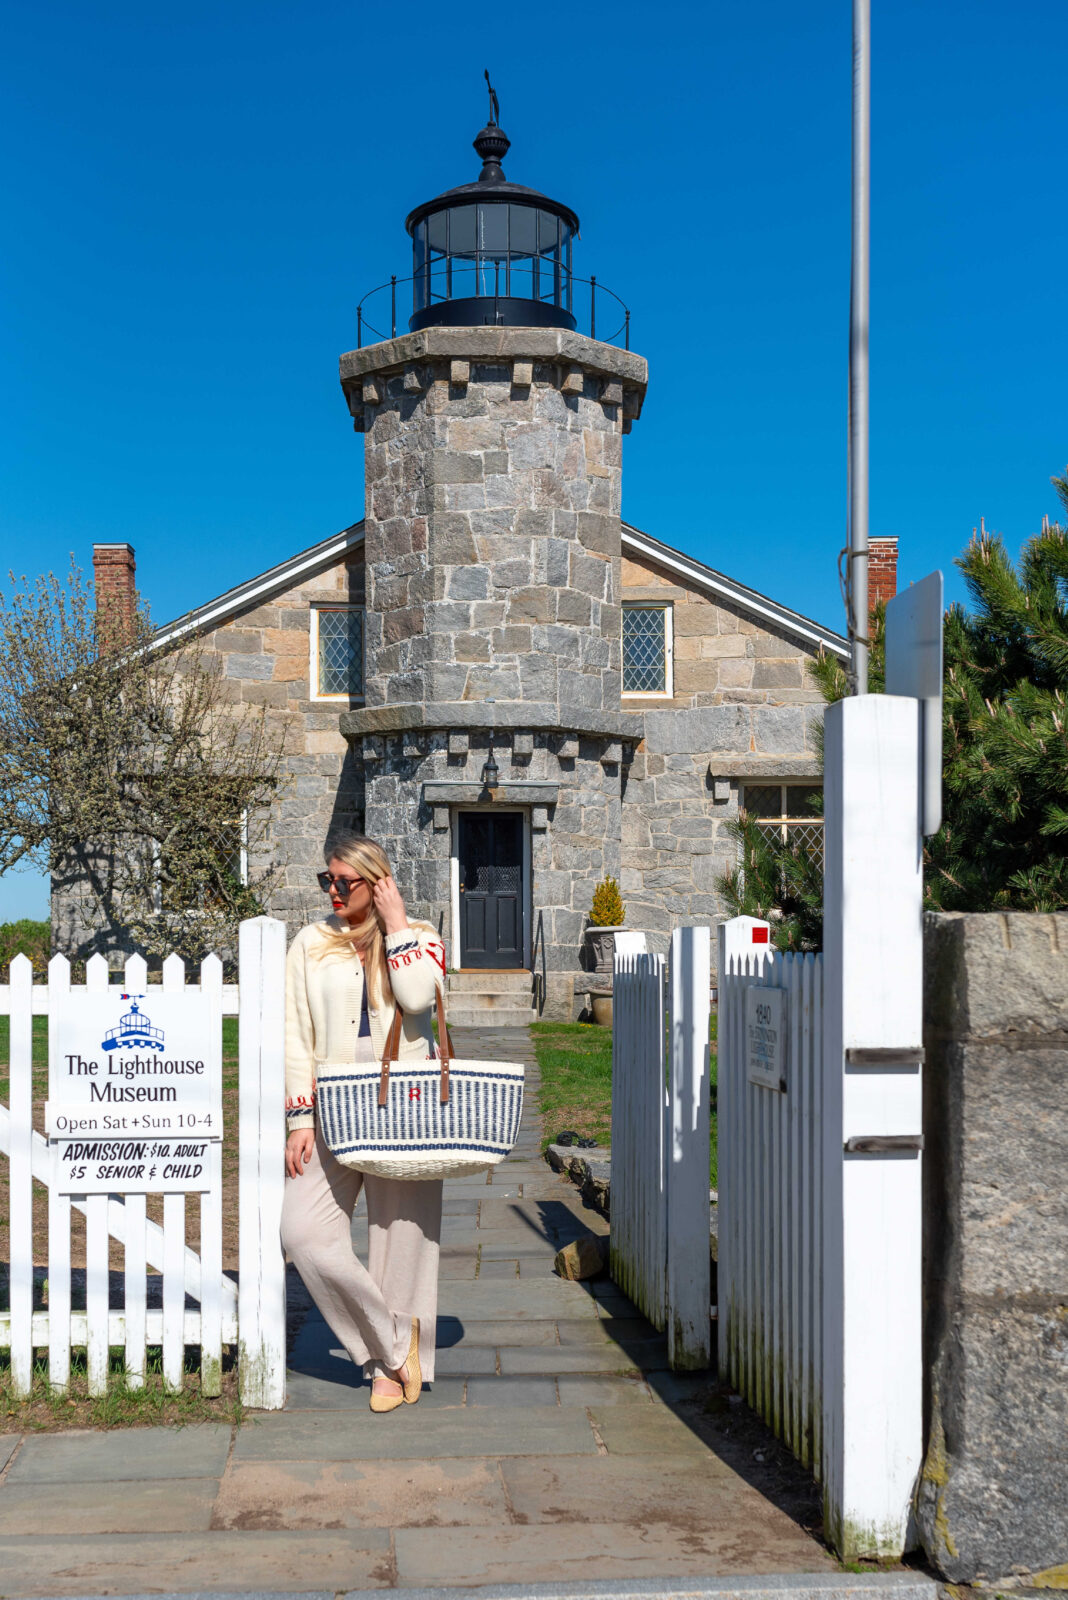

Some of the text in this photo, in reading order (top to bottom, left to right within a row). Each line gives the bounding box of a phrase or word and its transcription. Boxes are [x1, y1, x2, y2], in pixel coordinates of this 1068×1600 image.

[65, 1055, 205, 1080] The Lighthouse
[90, 1082, 177, 1102] Museum
[409, 1087, 421, 1101] R
[56, 1116, 98, 1133] Open
[103, 1115, 128, 1129] Sat
[178, 1113, 213, 1128] 10-4
[62, 1142, 150, 1161] ADMISSION:
[173, 1144, 208, 1157] ADULT
[69, 1164, 203, 1180] $5 SENIOR & CHILD
